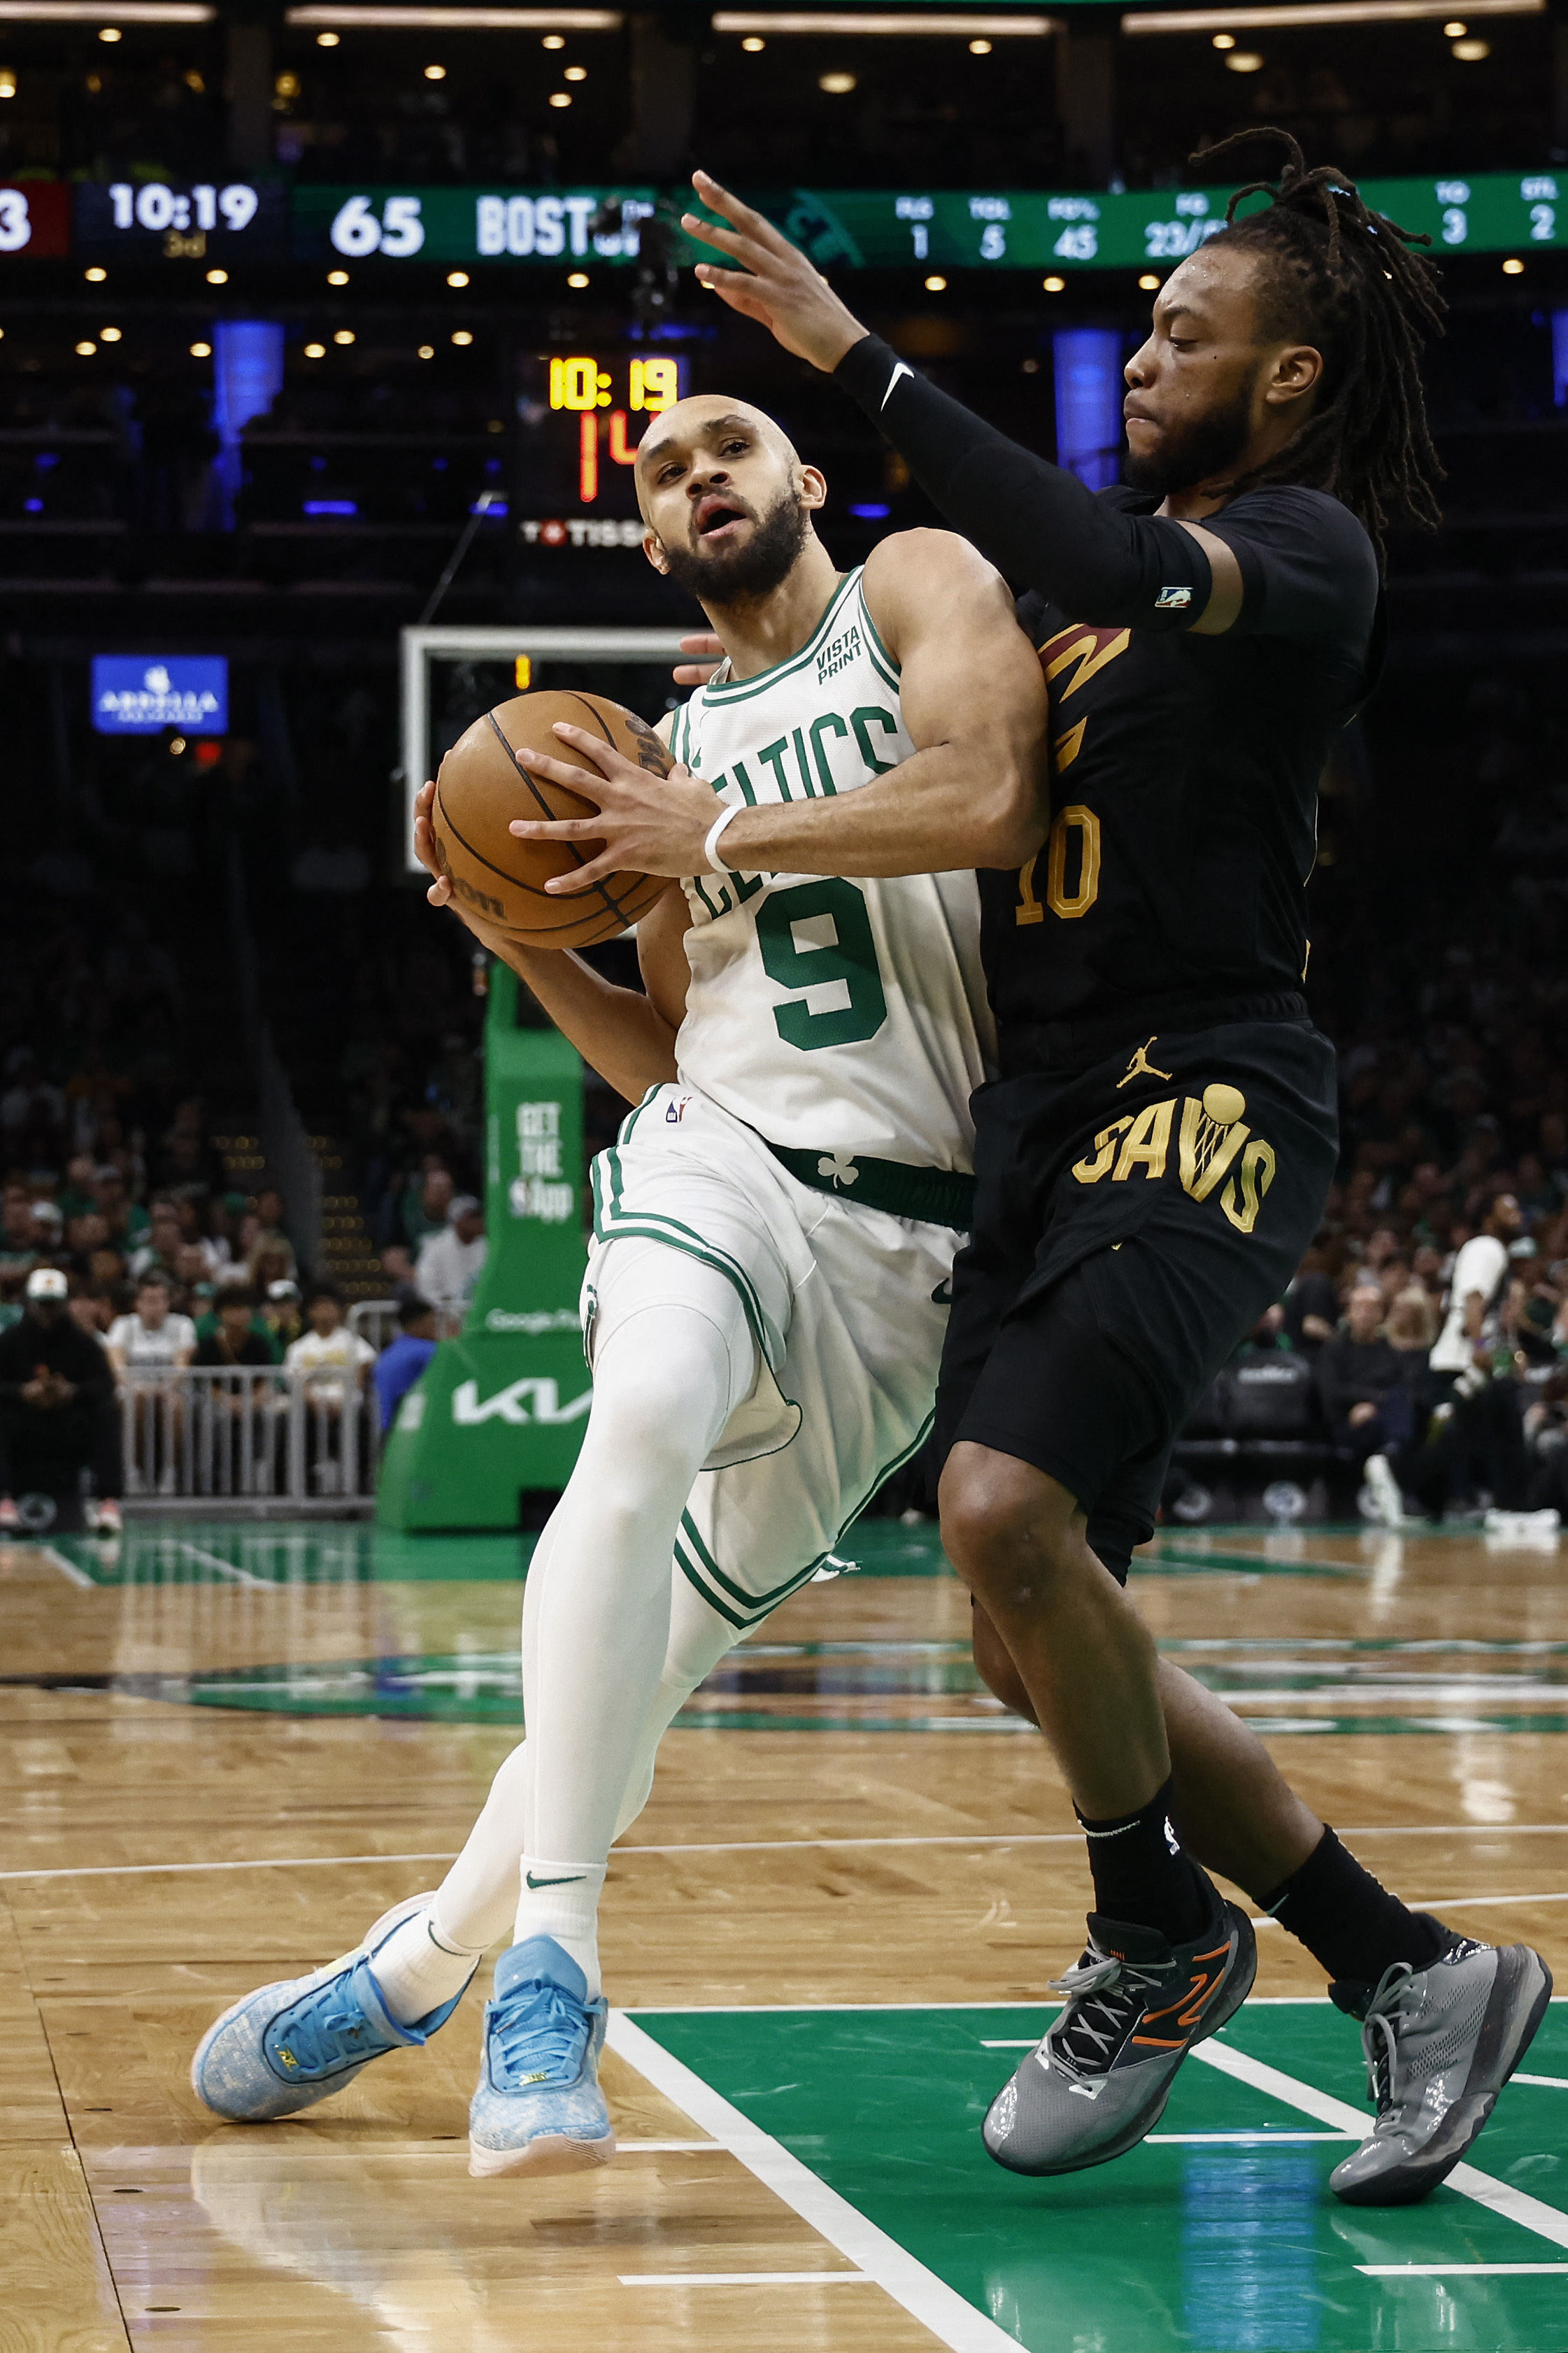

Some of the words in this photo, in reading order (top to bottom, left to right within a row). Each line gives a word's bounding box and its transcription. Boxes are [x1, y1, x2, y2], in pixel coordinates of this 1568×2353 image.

[108, 183, 259, 231] 10:19
[330, 196, 425, 257] 65
[1442, 208, 1468, 245] 3
[1530, 204, 1557, 241] 2
[911, 223, 929, 260] 1
[980, 223, 1006, 260] 5
[816, 625, 860, 671] VISTA
[818, 641, 862, 686] PRINT
[691, 706, 898, 920] TICS
[1015, 804, 1102, 925] 10
[755, 876, 888, 1051] 9
